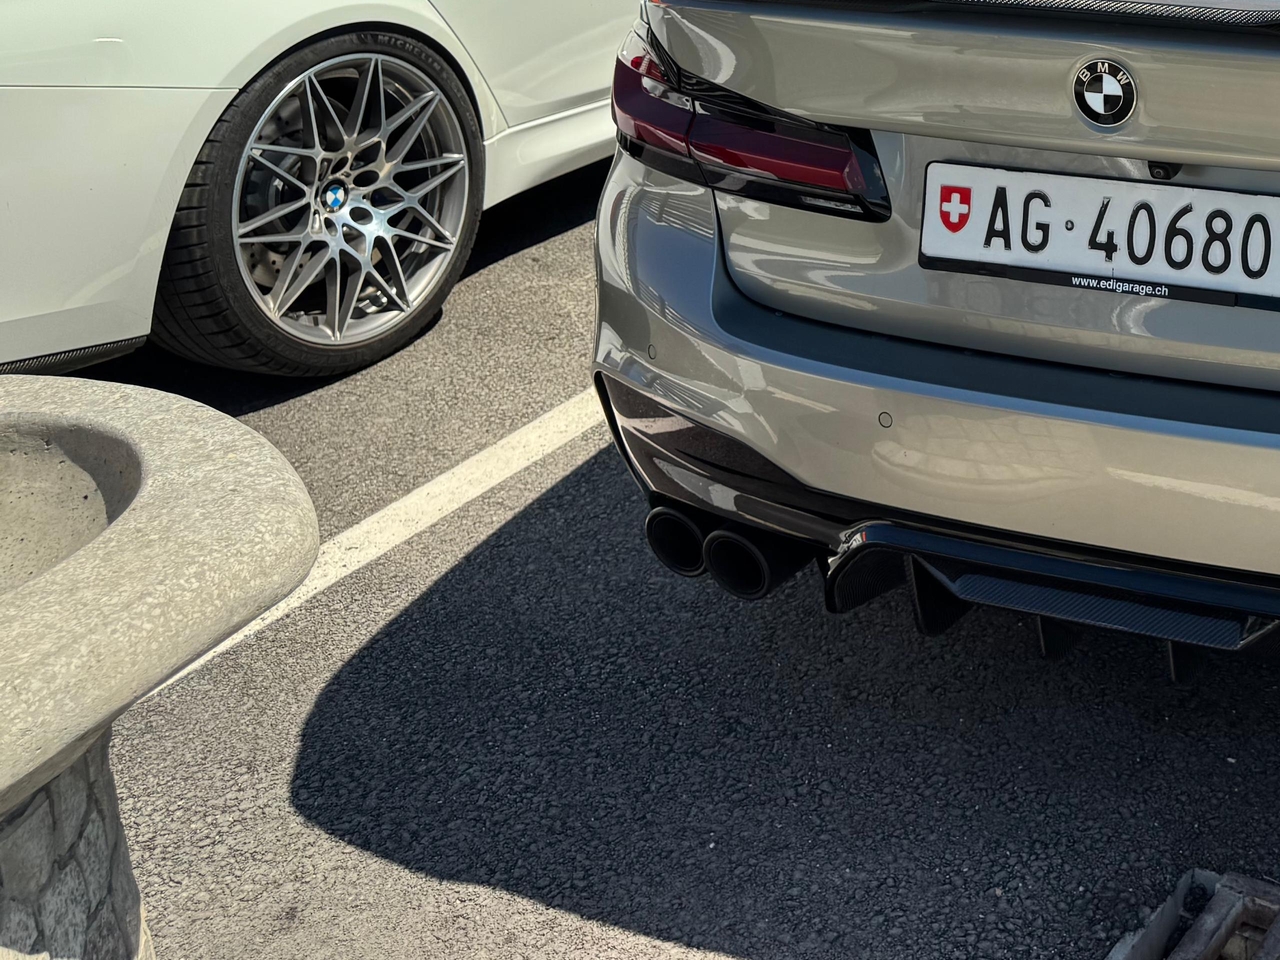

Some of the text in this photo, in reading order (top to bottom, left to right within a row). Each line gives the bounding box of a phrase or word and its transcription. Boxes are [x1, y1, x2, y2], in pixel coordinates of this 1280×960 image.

[378, 35, 441, 71] MICHELIN
[1079, 62, 1130, 85] BMW
[1072, 276, 1169, 296] www.edigarage.ch
